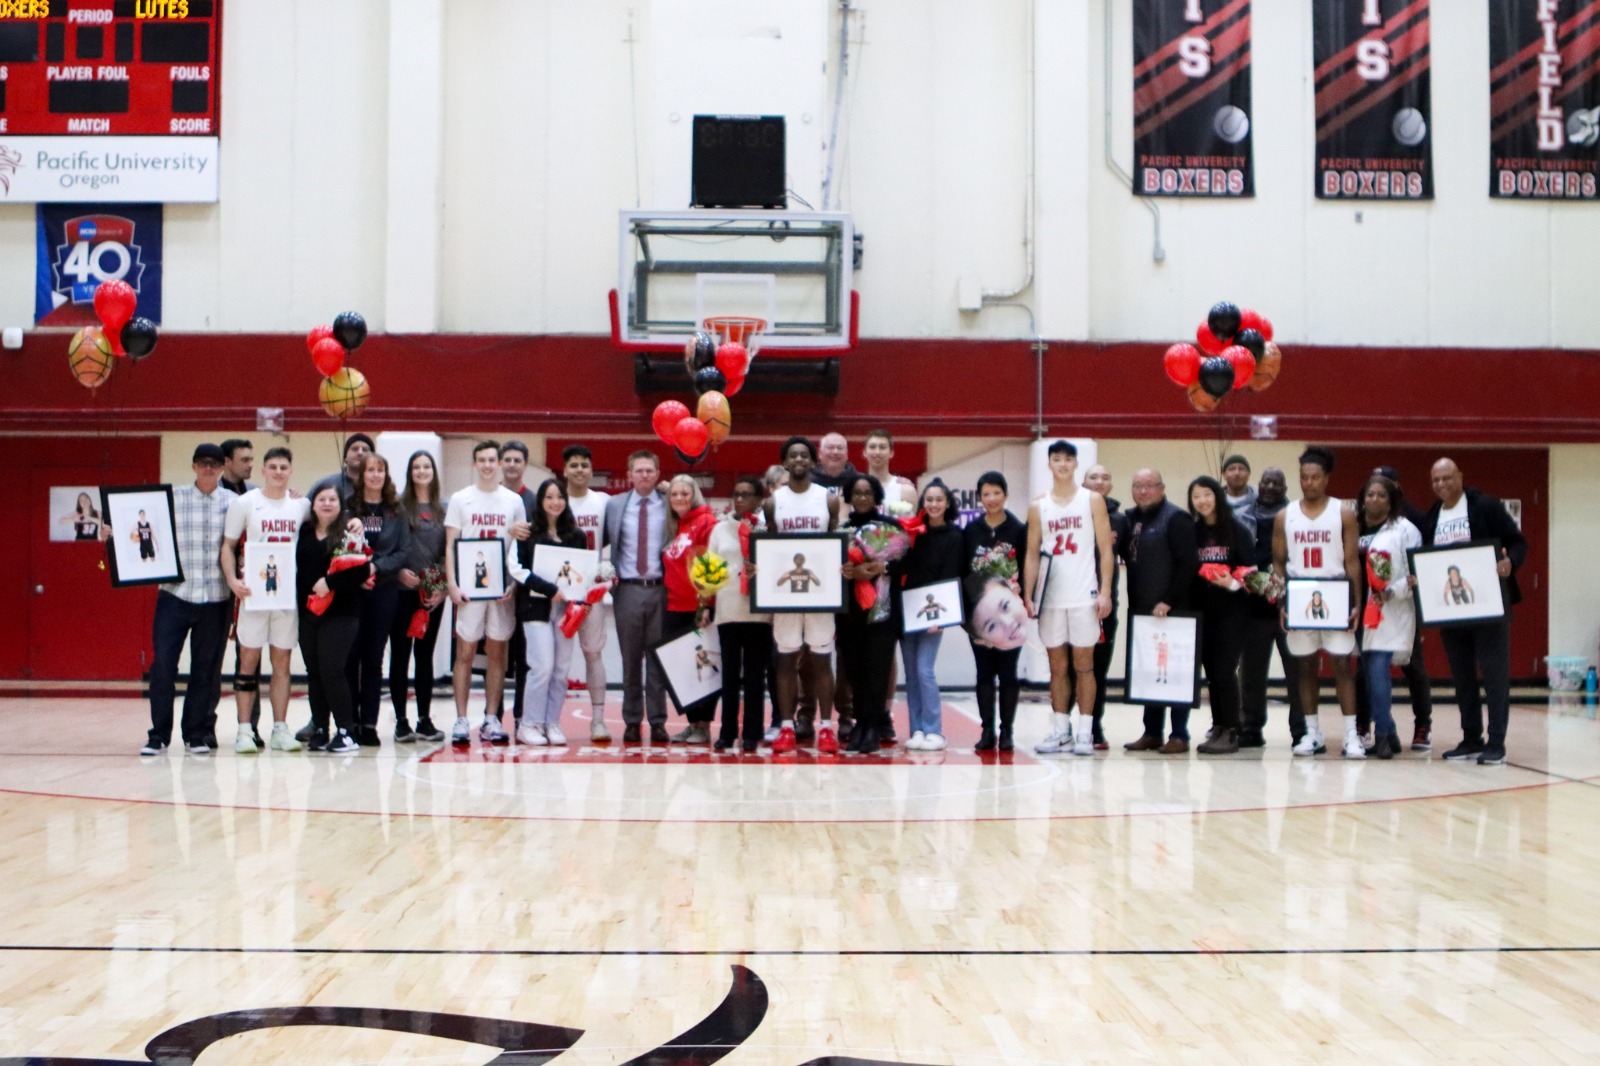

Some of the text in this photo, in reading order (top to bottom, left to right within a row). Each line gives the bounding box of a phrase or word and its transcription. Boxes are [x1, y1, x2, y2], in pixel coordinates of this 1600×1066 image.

[68, 9, 113, 23] PERIOD
[135, 0, 189, 18] LUTES
[47, 66, 129, 80] PLAYER FOUL
[170, 66, 210, 80] FOULS
[67, 118, 110, 132] MATCH
[170, 118, 210, 132] SCORE
[37, 151, 207, 173] Pacific University
[1141, 154, 1246, 168] PACIFIC UNIVERSITY
[1321, 158, 1424, 170] PACIFIC UNIVERSITY
[1497, 158, 1597, 170] PACIFIC UNIVERSITY
[60, 173, 119, 189] Oregon
[1144, 168, 1244, 193] BOXERS
[1324, 170, 1422, 195] BOXERS
[1500, 170, 1596, 197] BOXERS
[63, 241, 131, 283] 40
[261, 519, 296, 533] PACIFIC
[471, 513, 506, 526] PACIFIC
[782, 516, 820, 530] PACIFIC
[1048, 516, 1082, 533] PACIFIC
[1436, 519, 1470, 536] ACIFIC
[1294, 530, 1331, 543] PACIFIC
[1053, 533, 1078, 555] 24
[1304, 547, 1323, 568] 10
